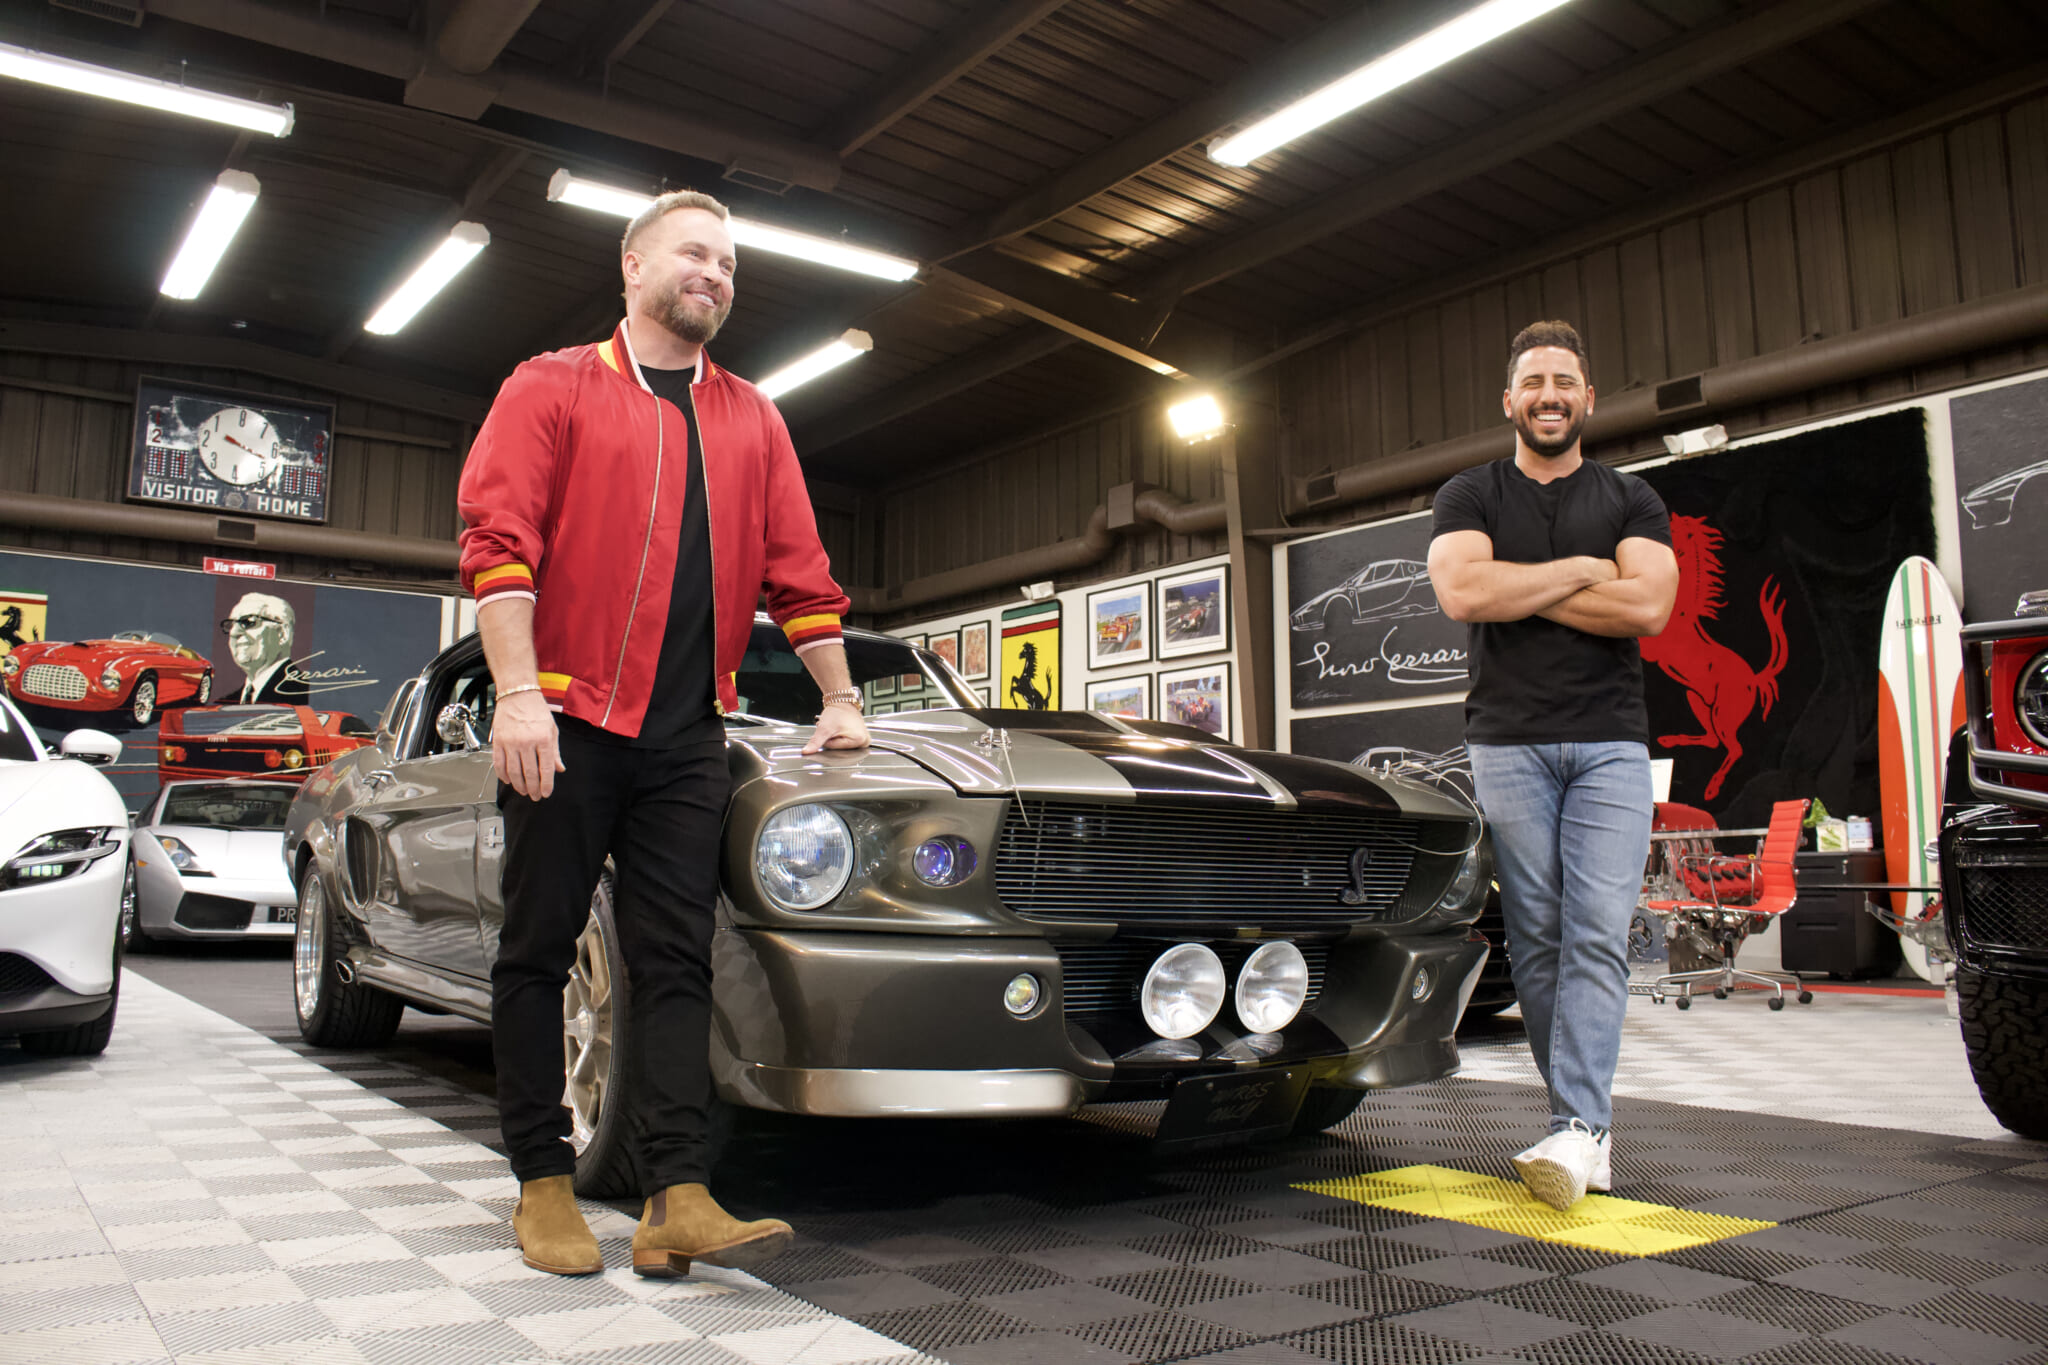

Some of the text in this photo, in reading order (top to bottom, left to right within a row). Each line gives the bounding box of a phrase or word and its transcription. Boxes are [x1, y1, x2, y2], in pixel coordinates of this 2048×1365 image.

[155, 411, 161, 425] 1
[214, 415, 220, 432] 1
[239, 410, 247, 427] 8
[152, 428, 162, 443] 2
[202, 430, 210, 447] 2
[260, 422, 269, 438] 7
[314, 434, 324, 449] 3
[271, 442, 278, 459] 6
[313, 452, 323, 466] 4
[210, 452, 218, 469] 3
[231, 465, 238, 482] 4
[257, 462, 266, 478] 5
[145, 482, 218, 504] VISITOR
[257, 496, 312, 516] HOME
[213, 561, 229, 573] Via
[1380, 626, 1469, 684] Ferrar
[277, 907, 297, 921] PR
